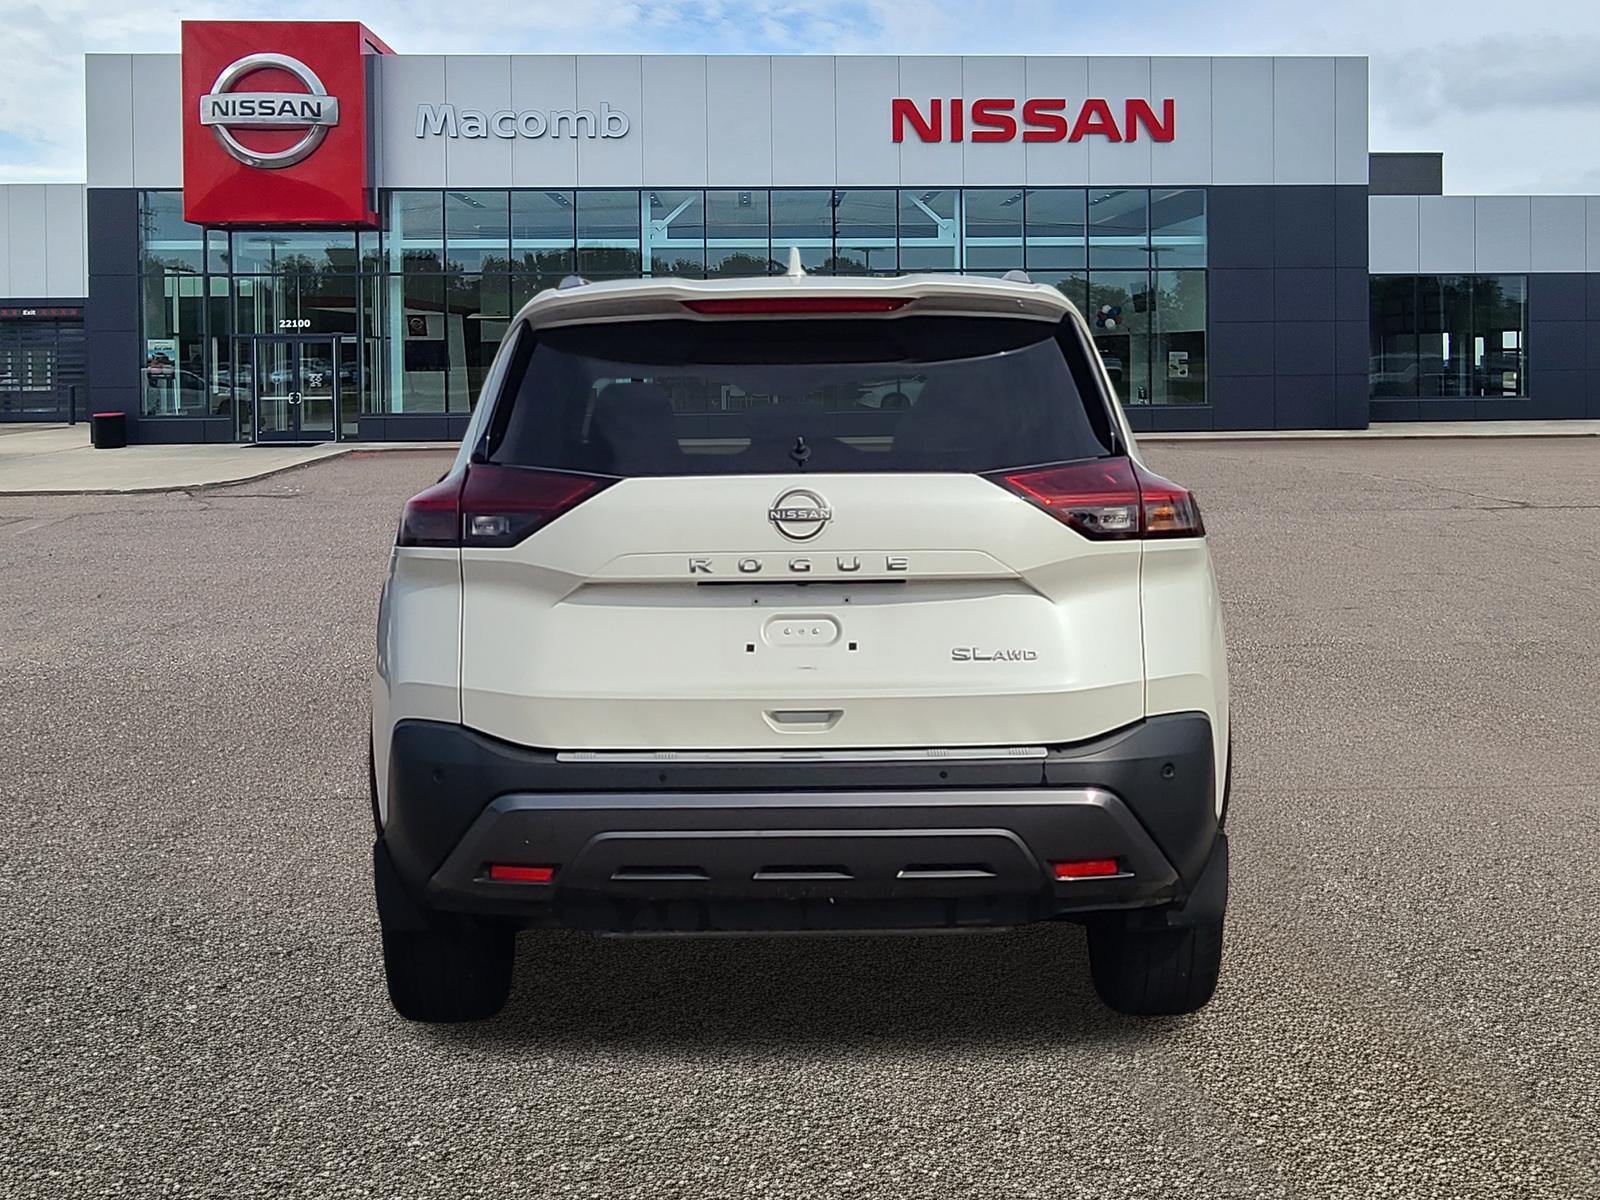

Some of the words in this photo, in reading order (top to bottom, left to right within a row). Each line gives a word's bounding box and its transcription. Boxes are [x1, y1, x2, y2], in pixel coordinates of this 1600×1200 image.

[211, 99, 322, 118] NISSAN
[415, 102, 630, 139] Macomb
[892, 98, 1176, 143] NISSAN
[279, 319, 312, 328] 22100
[769, 508, 832, 520] NISSAN
[688, 555, 909, 574] ROGUE
